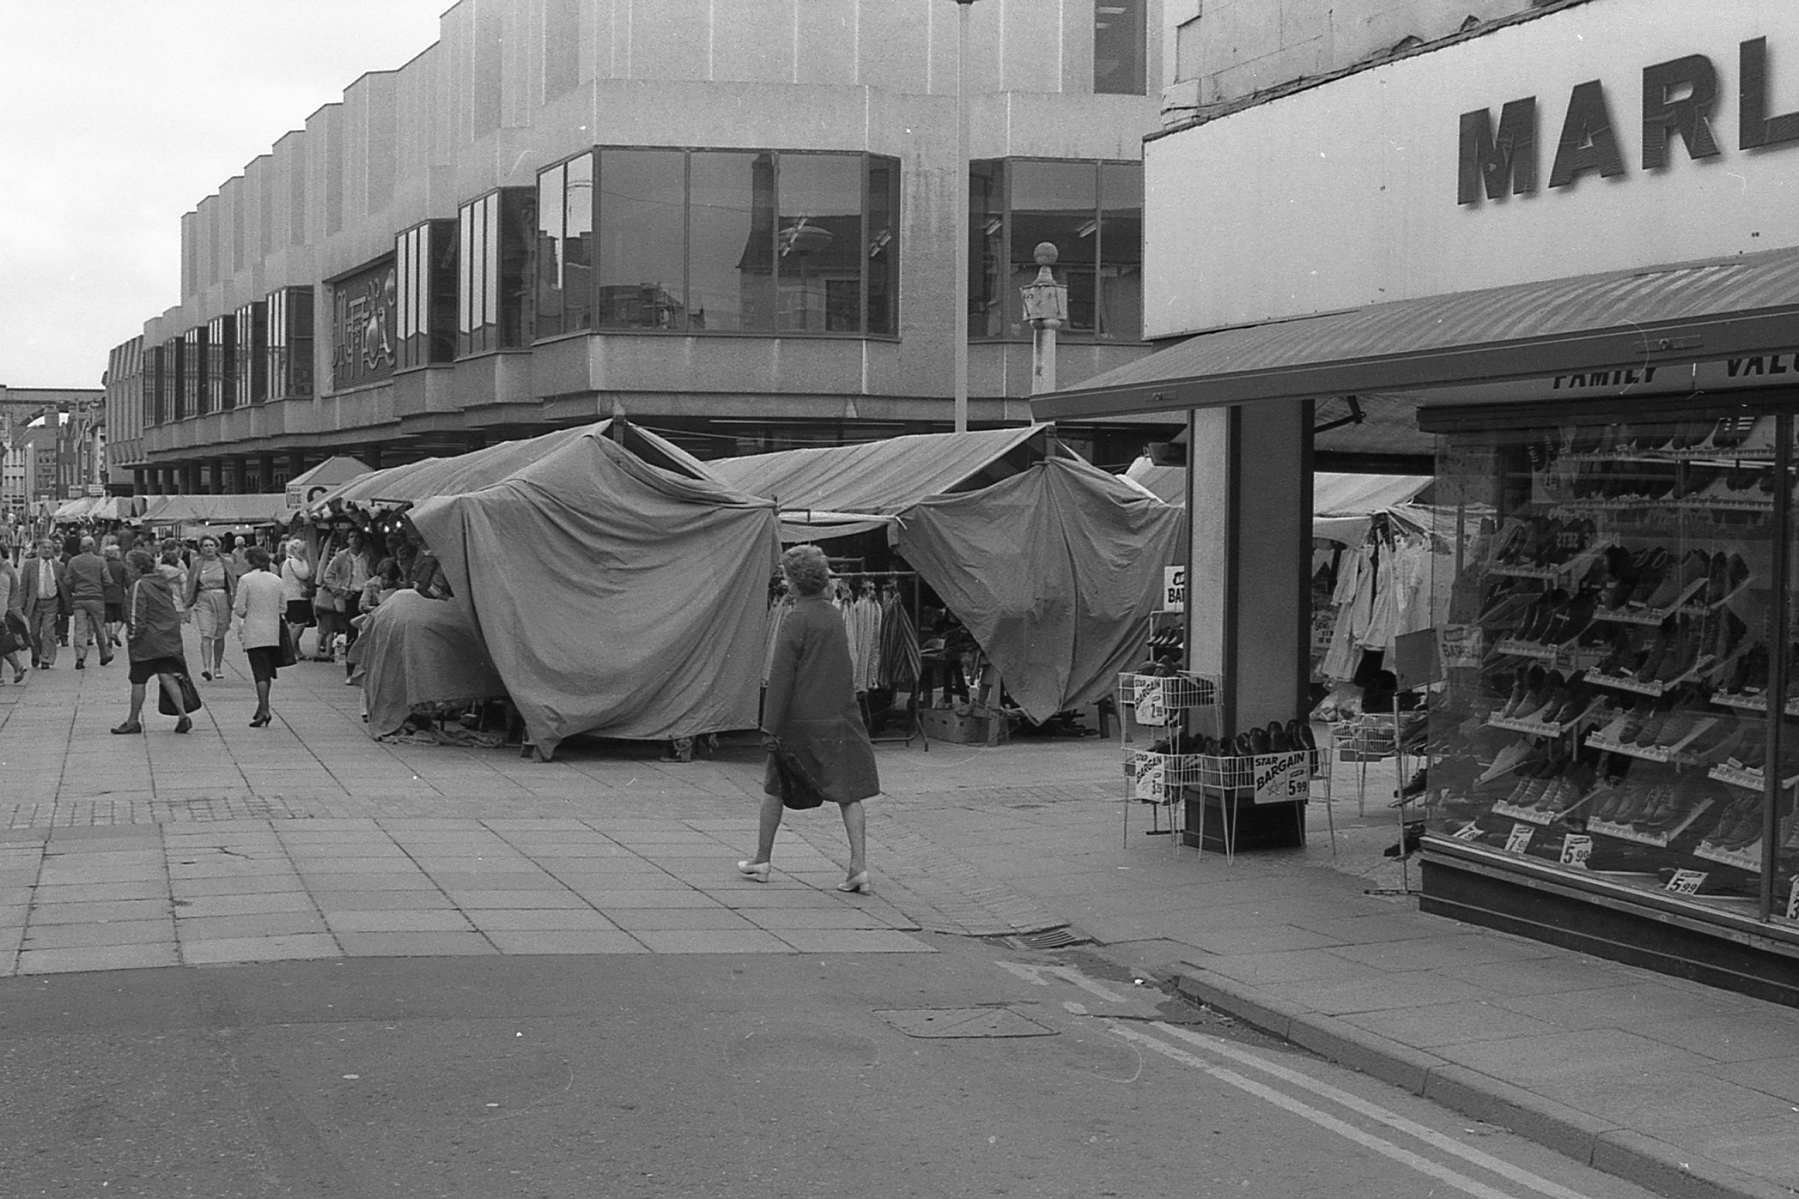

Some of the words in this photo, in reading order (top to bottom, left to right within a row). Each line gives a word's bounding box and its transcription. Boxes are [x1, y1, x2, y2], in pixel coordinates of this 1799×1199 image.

[1457, 36, 1799, 206] MARL
[1256, 756, 1278, 766] STAR
[1256, 752, 1305, 791] BARGAIN
